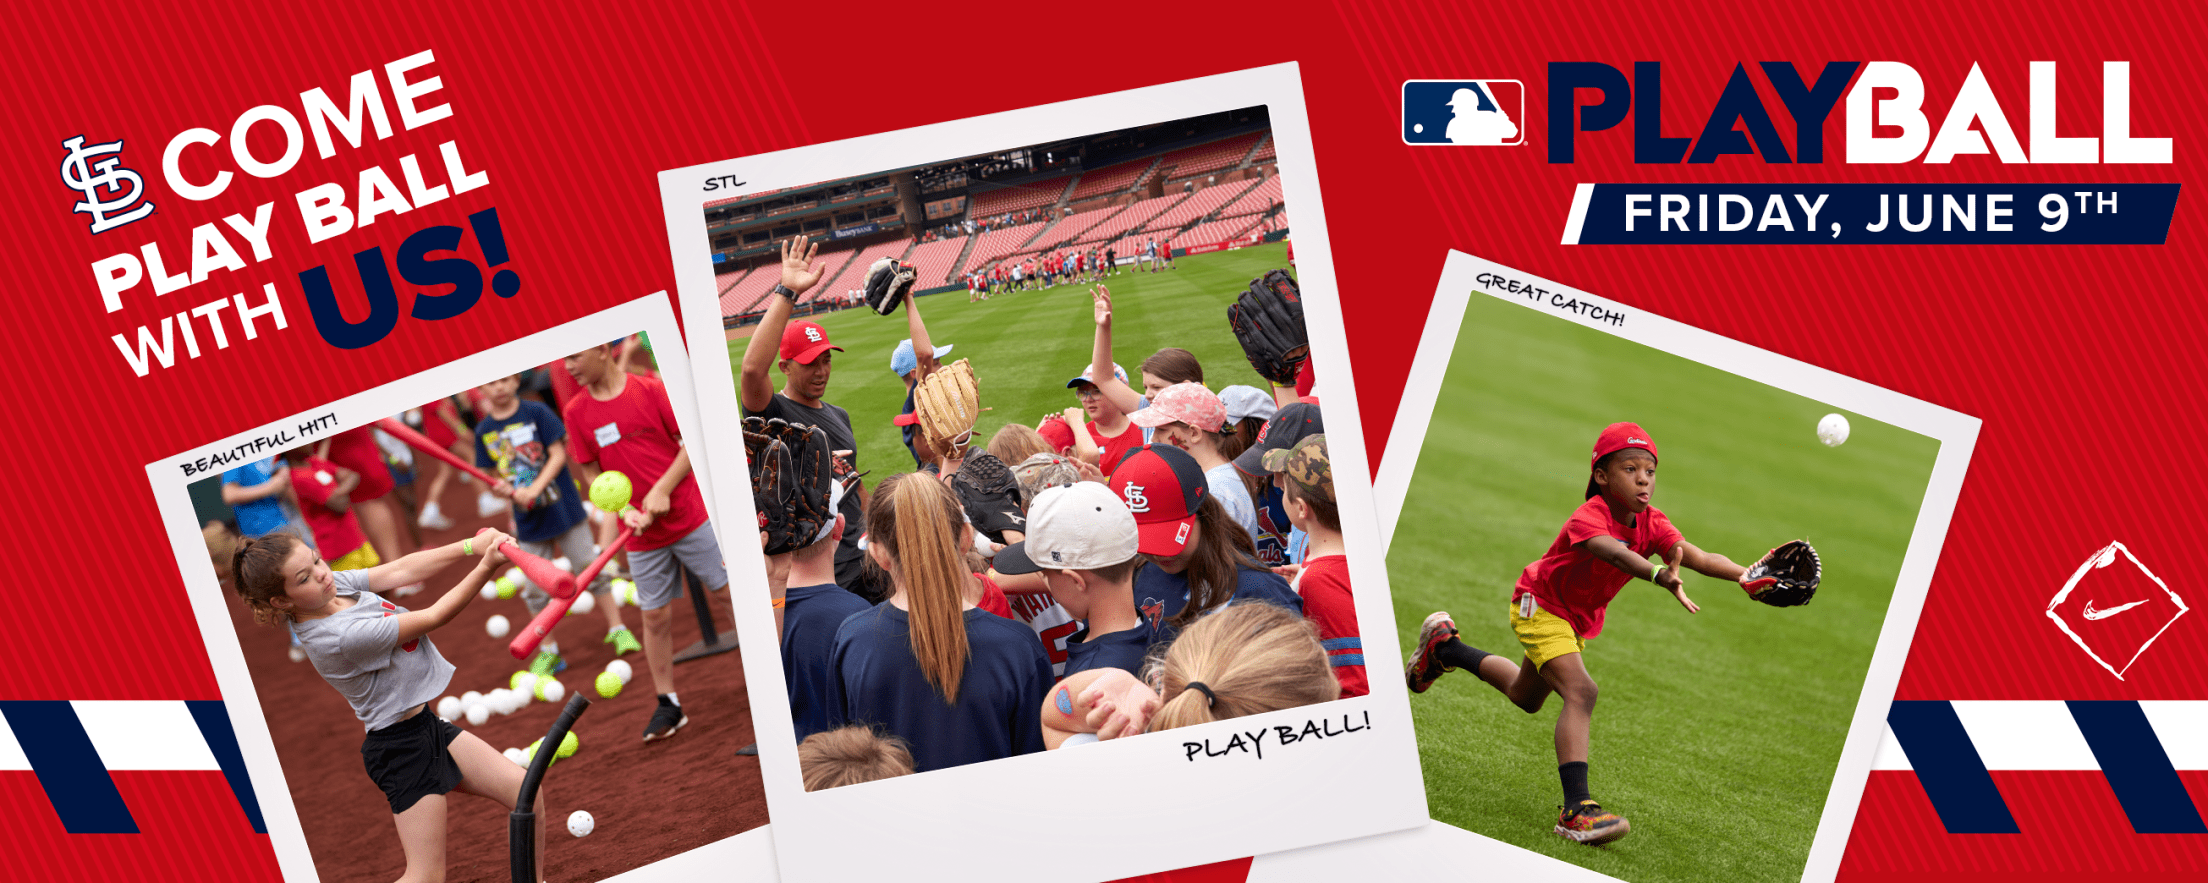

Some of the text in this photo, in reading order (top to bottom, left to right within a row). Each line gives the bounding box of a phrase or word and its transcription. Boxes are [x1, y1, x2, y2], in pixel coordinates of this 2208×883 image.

[162, 48, 454, 201] COME
[702, 174, 747, 192] STL
[92, 140, 490, 314] PLAY BALL
[1625, 194, 1841, 238] FRIDAY,
[1866, 194, 2013, 232] JUNE
[111, 206, 521, 378] WITH US!
[1476, 272, 1626, 326] GREAT CATCH!
[180, 412, 337, 477] BEAUTIFUL HIT!
[1182, 710, 1371, 762] PLAY BALL!
